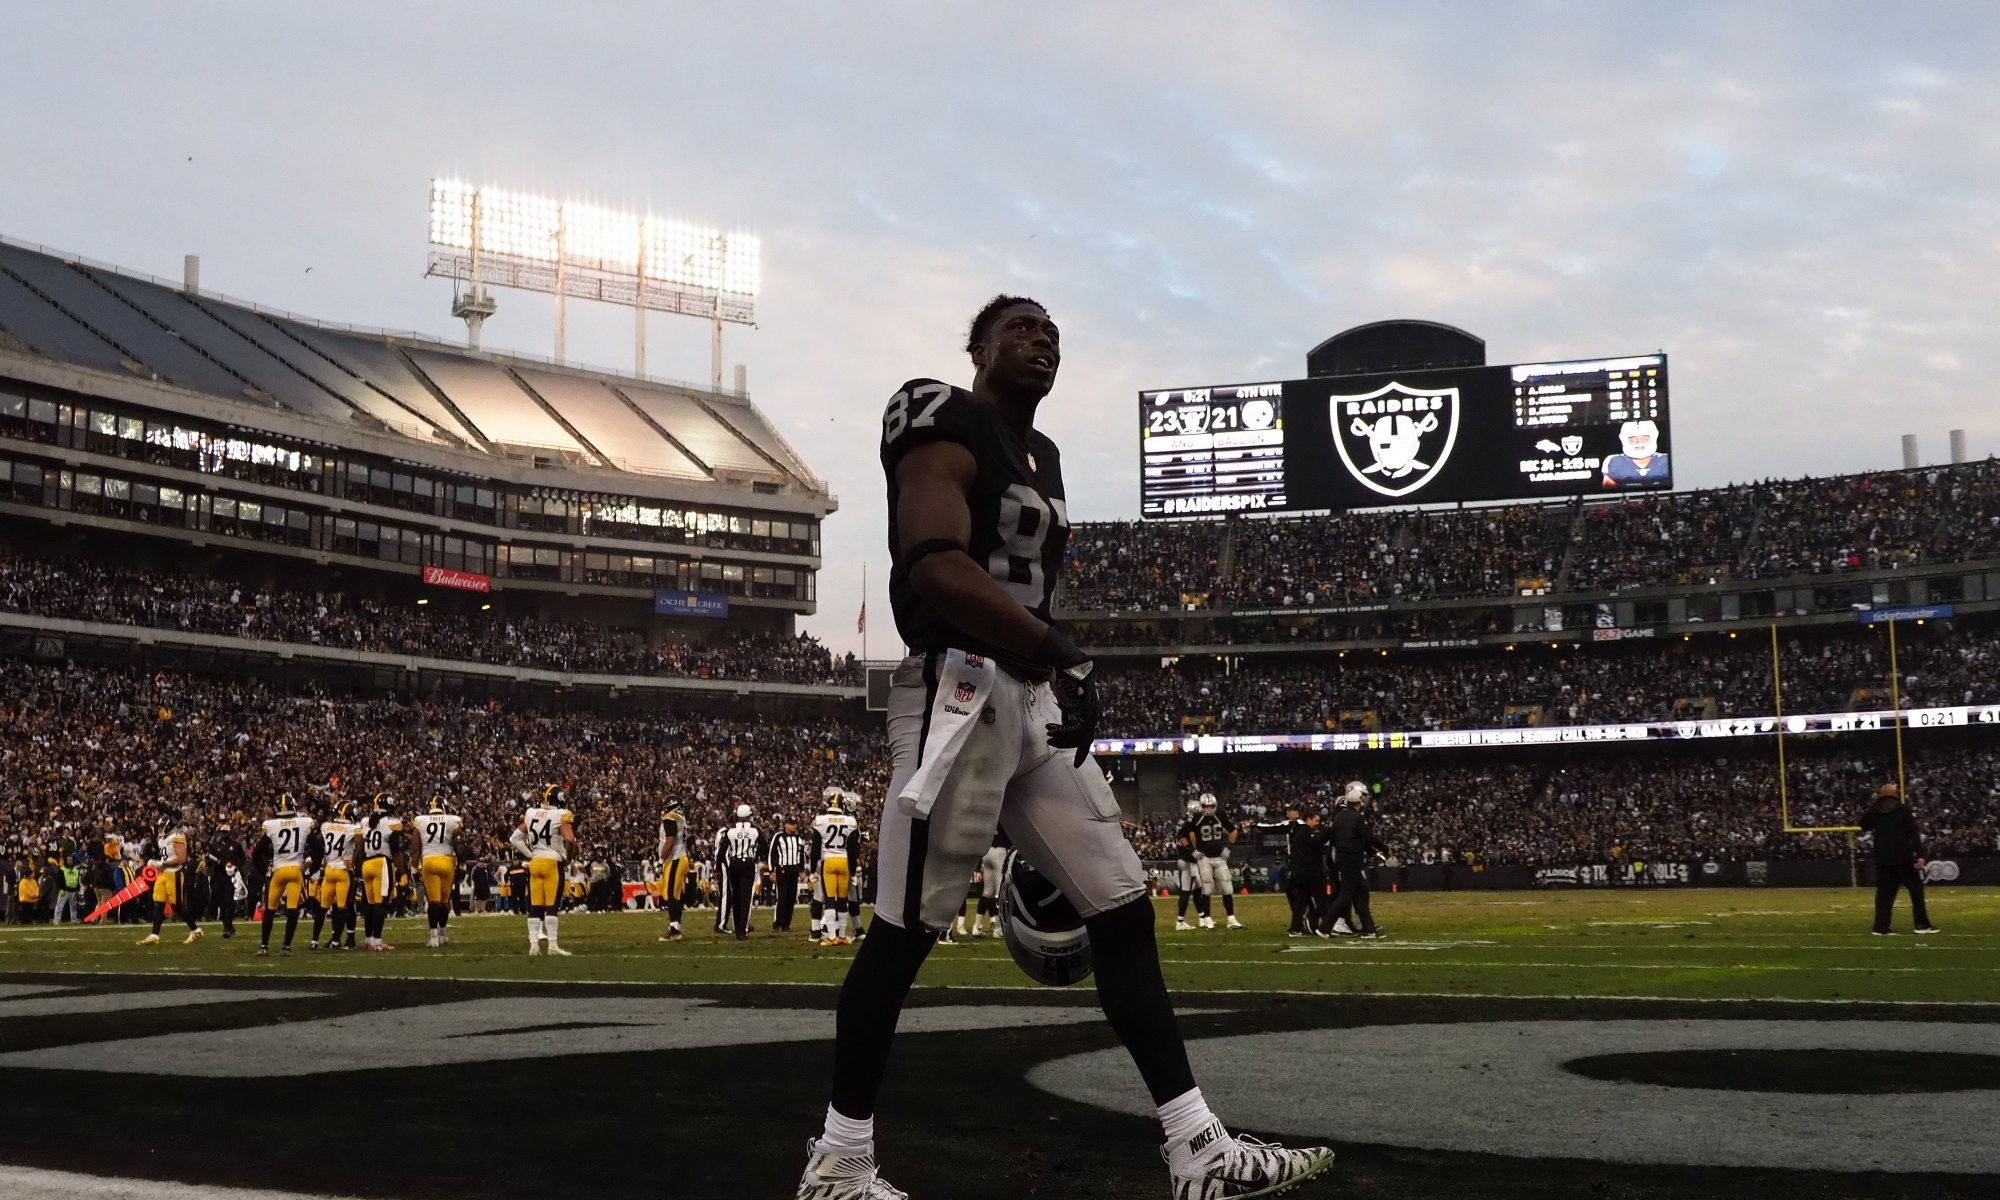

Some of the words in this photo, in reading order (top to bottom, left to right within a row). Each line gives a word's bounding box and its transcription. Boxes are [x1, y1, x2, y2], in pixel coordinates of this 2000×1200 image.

[1237, 387, 1258, 398] 4TH
[884, 383, 951, 444] 87
[1347, 396, 1443, 415] RAIDERS
[1150, 410, 1177, 433] 23
[1211, 406, 1237, 429] 21
[1540, 459, 1554, 471] 24
[1164, 495, 1267, 513] #RAIDERSPIX
[426, 568, 487, 590] Budweiser
[1596, 630, 1619, 640] 95.7
[1624, 628, 1654, 638] GAME
[955, 687, 973, 701] NFL
[1831, 717, 1857, 732] PIT
[1860, 714, 1880, 730] 21
[1921, 712, 1954, 725] 0:21
[1421, 733, 1470, 745] INTERESTED
[1482, 731, 1522, 744] PREMIUM
[1562, 728, 1584, 740] CALL
[1700, 722, 1732, 737] OAK
[1734, 720, 1756, 736] 23
[278, 827, 300, 854] 21
[426, 822, 446, 844] 91
[529, 819, 552, 845] 54
[737, 832, 750, 840] 62
[825, 824, 849, 849] 25
[325, 832, 346, 857] 34
[1189, 1127, 1215, 1156] NIKE
